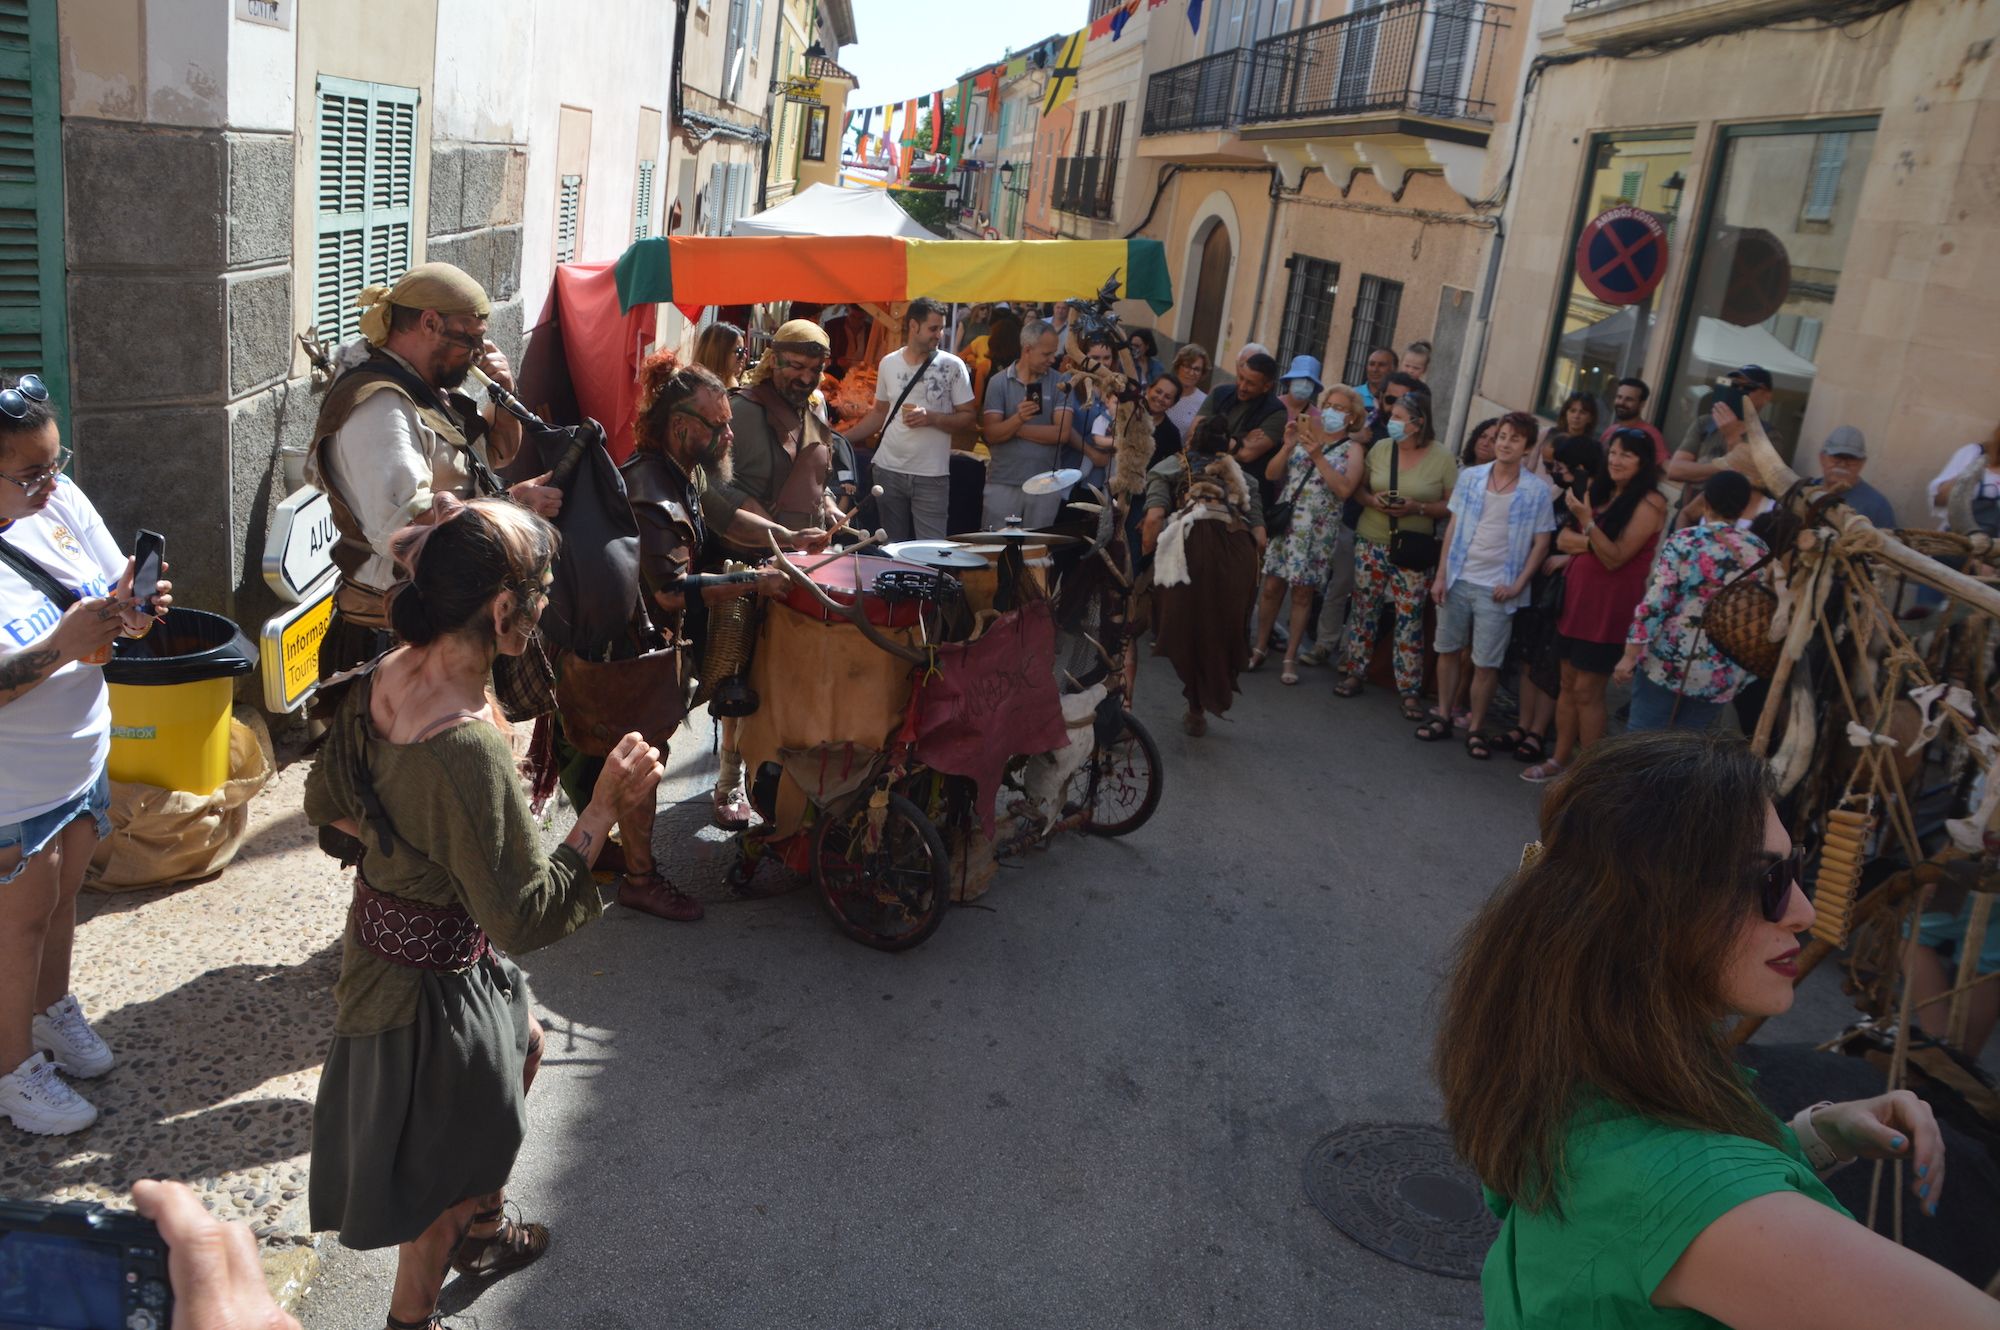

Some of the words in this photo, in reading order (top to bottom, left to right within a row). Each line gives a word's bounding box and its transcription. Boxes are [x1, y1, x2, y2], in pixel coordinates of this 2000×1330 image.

[310, 512, 338, 557] AJU
[3, 572, 107, 647] Emites
[286, 616, 329, 661] Informac
[288, 652, 318, 686] Touris
